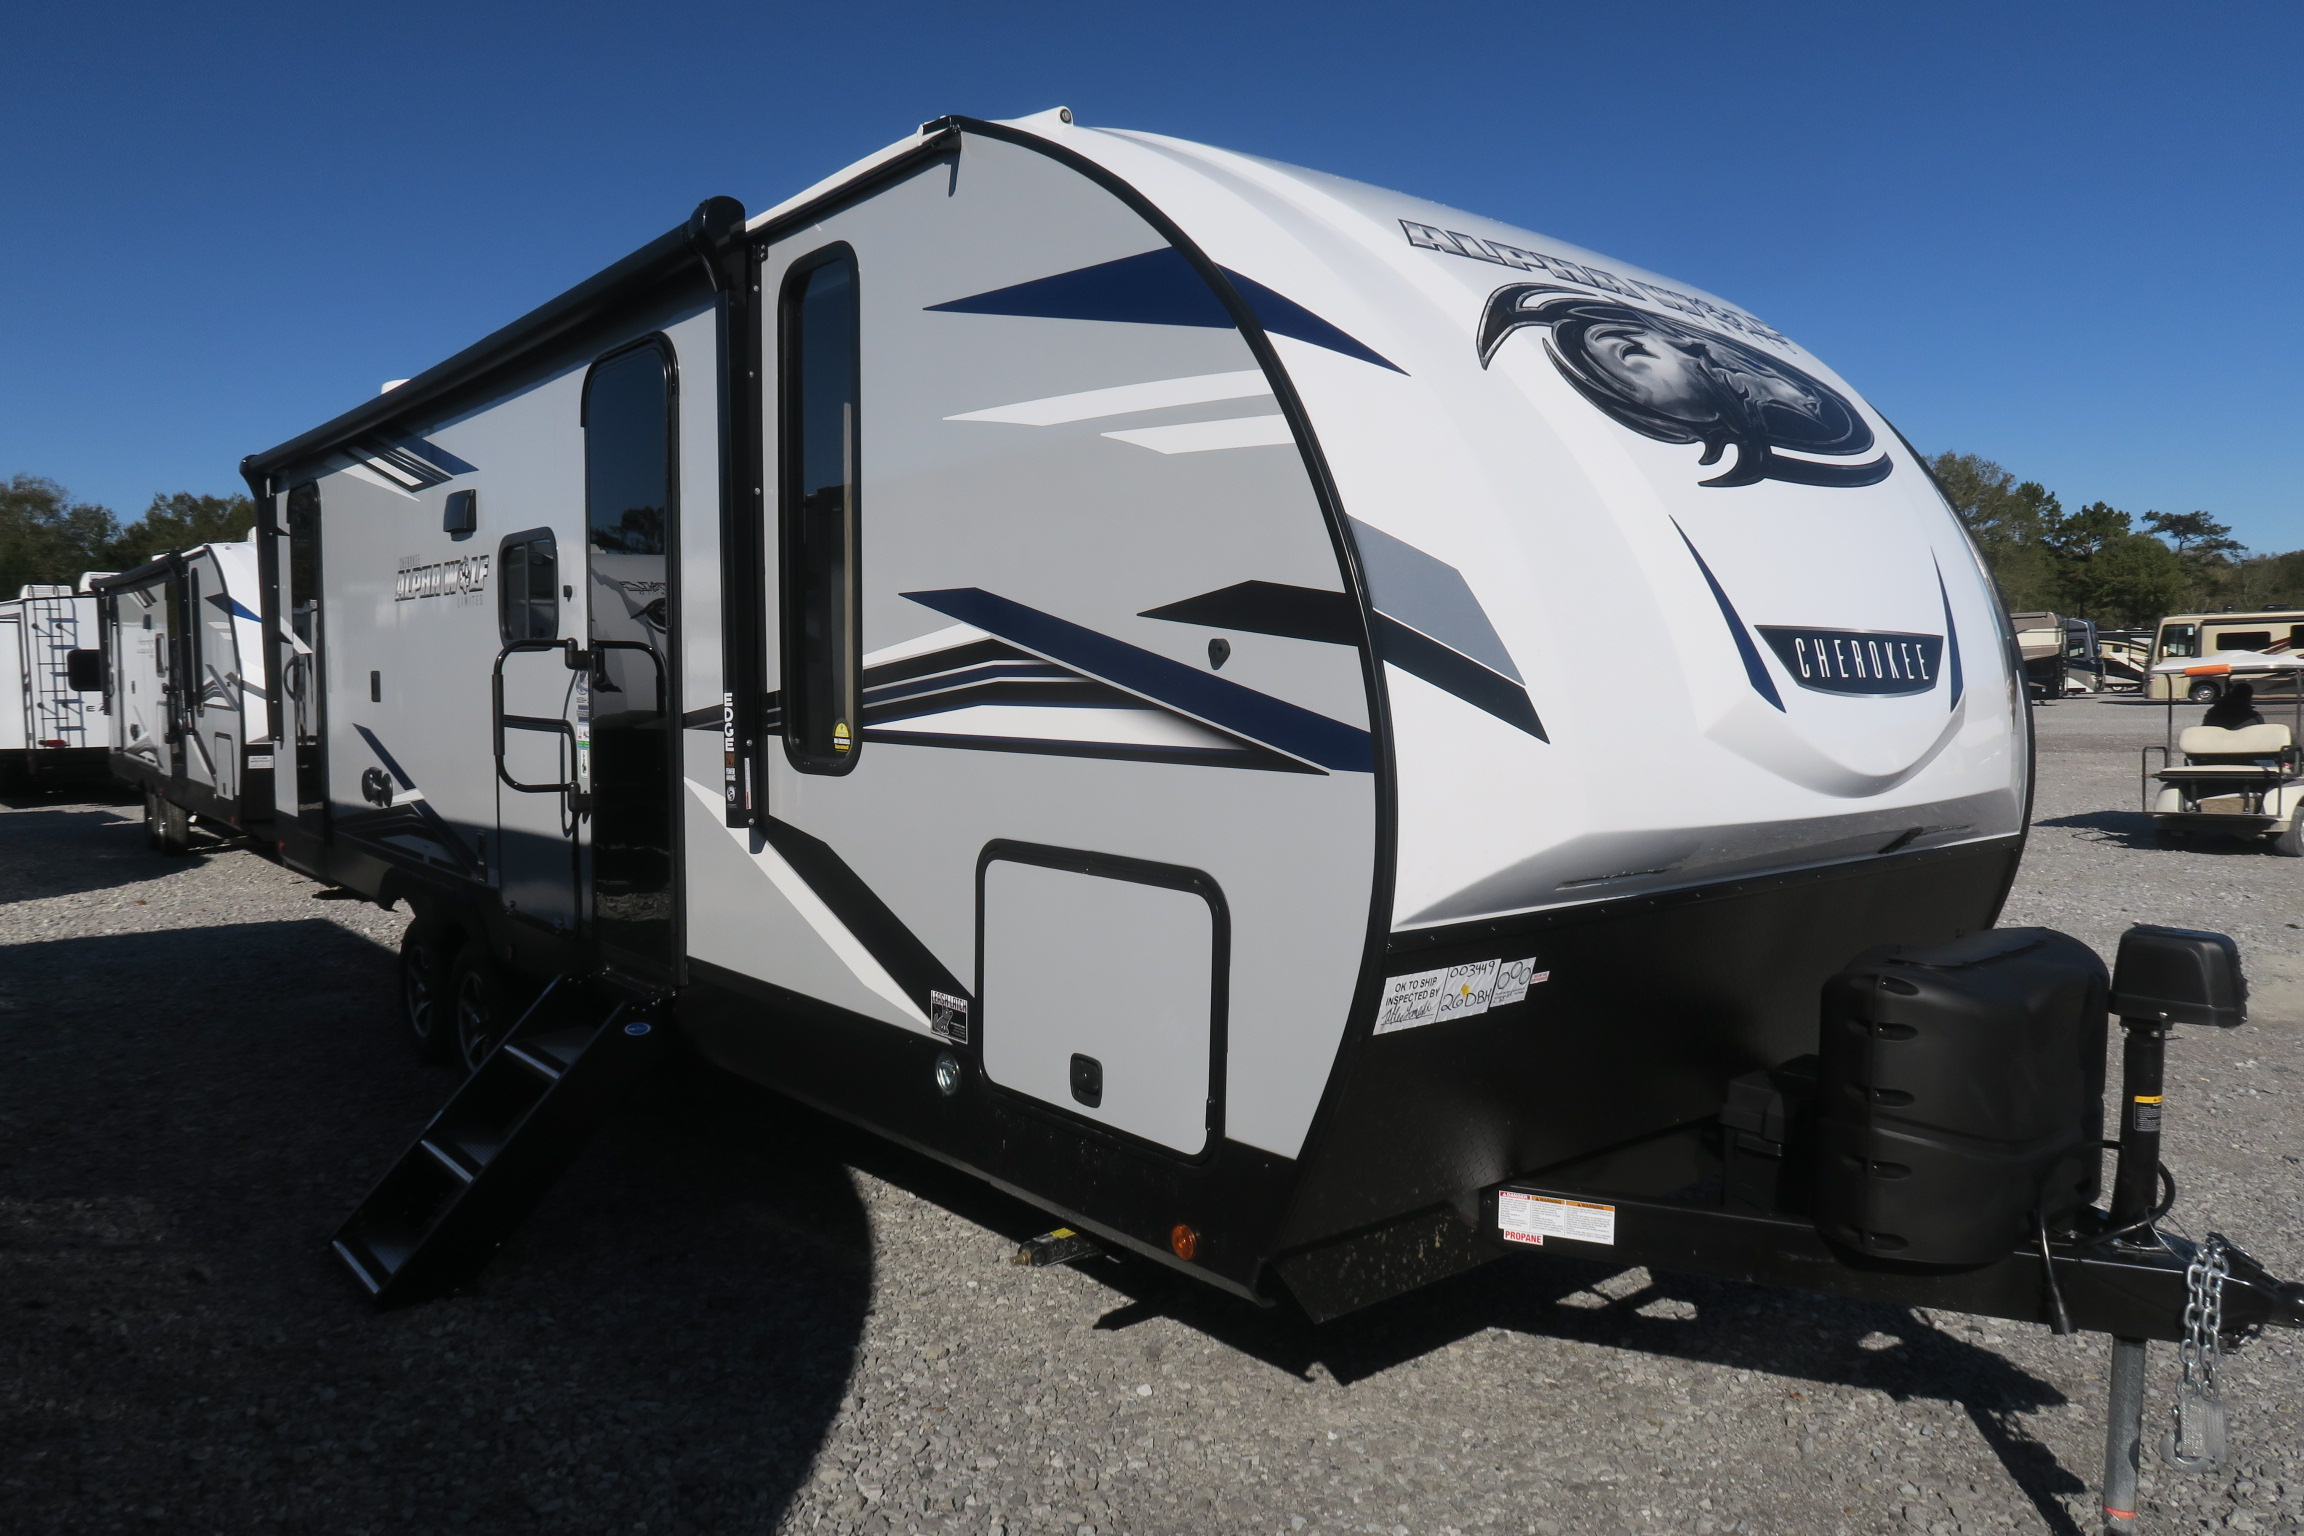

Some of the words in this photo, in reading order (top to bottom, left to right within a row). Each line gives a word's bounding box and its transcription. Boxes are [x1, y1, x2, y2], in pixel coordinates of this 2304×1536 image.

[1398, 219, 1647, 301] ALPHA
[395, 563, 441, 602] ALPHA
[1795, 637, 1929, 680] CHEROKEE
[724, 692, 735, 752] EDGE
[1450, 961, 1495, 978] 003449
[1385, 991, 1428, 1006] INSPECTED
[1430, 988, 1440, 998] BY
[1395, 983, 1407, 992] OK
[1409, 980, 1418, 990] TO
[1420, 977, 1437, 988] SHIP
[1505, 1231, 1542, 1243] PROPANE
